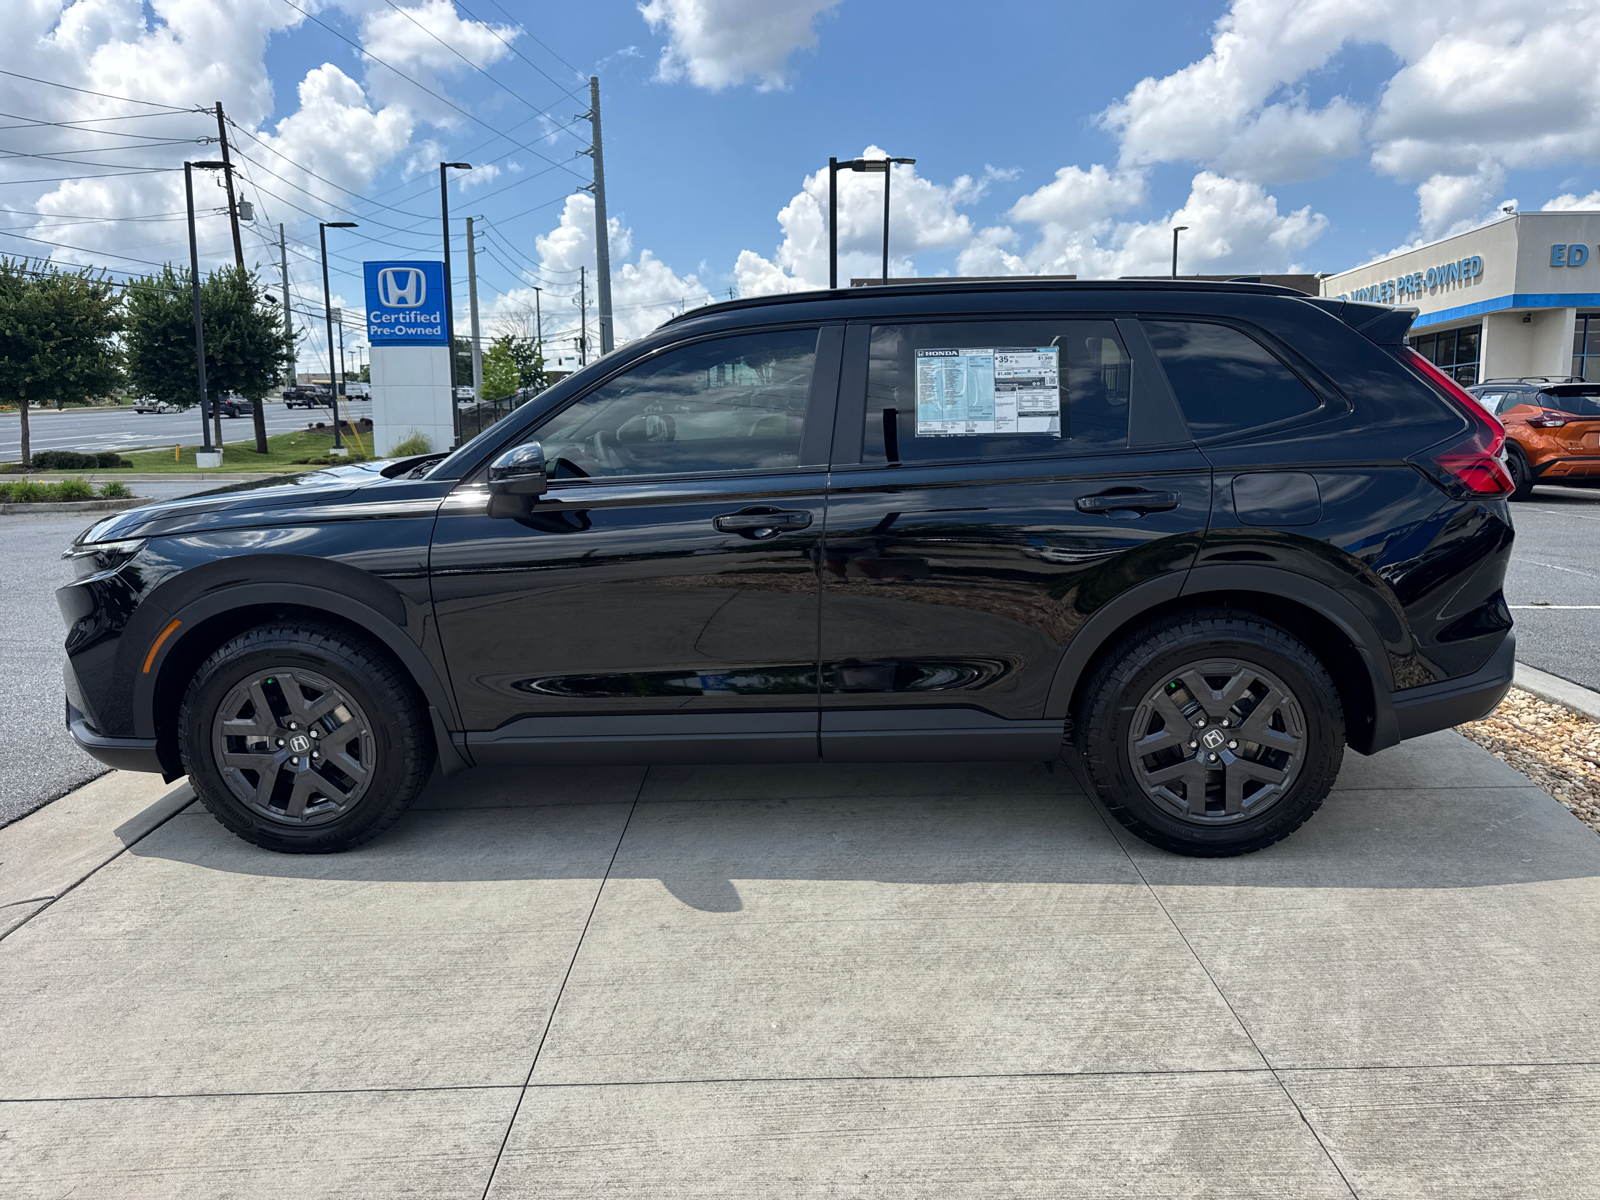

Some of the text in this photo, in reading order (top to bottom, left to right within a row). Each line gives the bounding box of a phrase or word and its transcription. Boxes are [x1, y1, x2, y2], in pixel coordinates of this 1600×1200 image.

[1550, 244, 1589, 267] ED
[1396, 255, 1483, 296] PRE-OWNED
[370, 311, 440, 323] Certified
[370, 325, 441, 335] Pre-Owned
[999, 355, 1009, 363] 35
